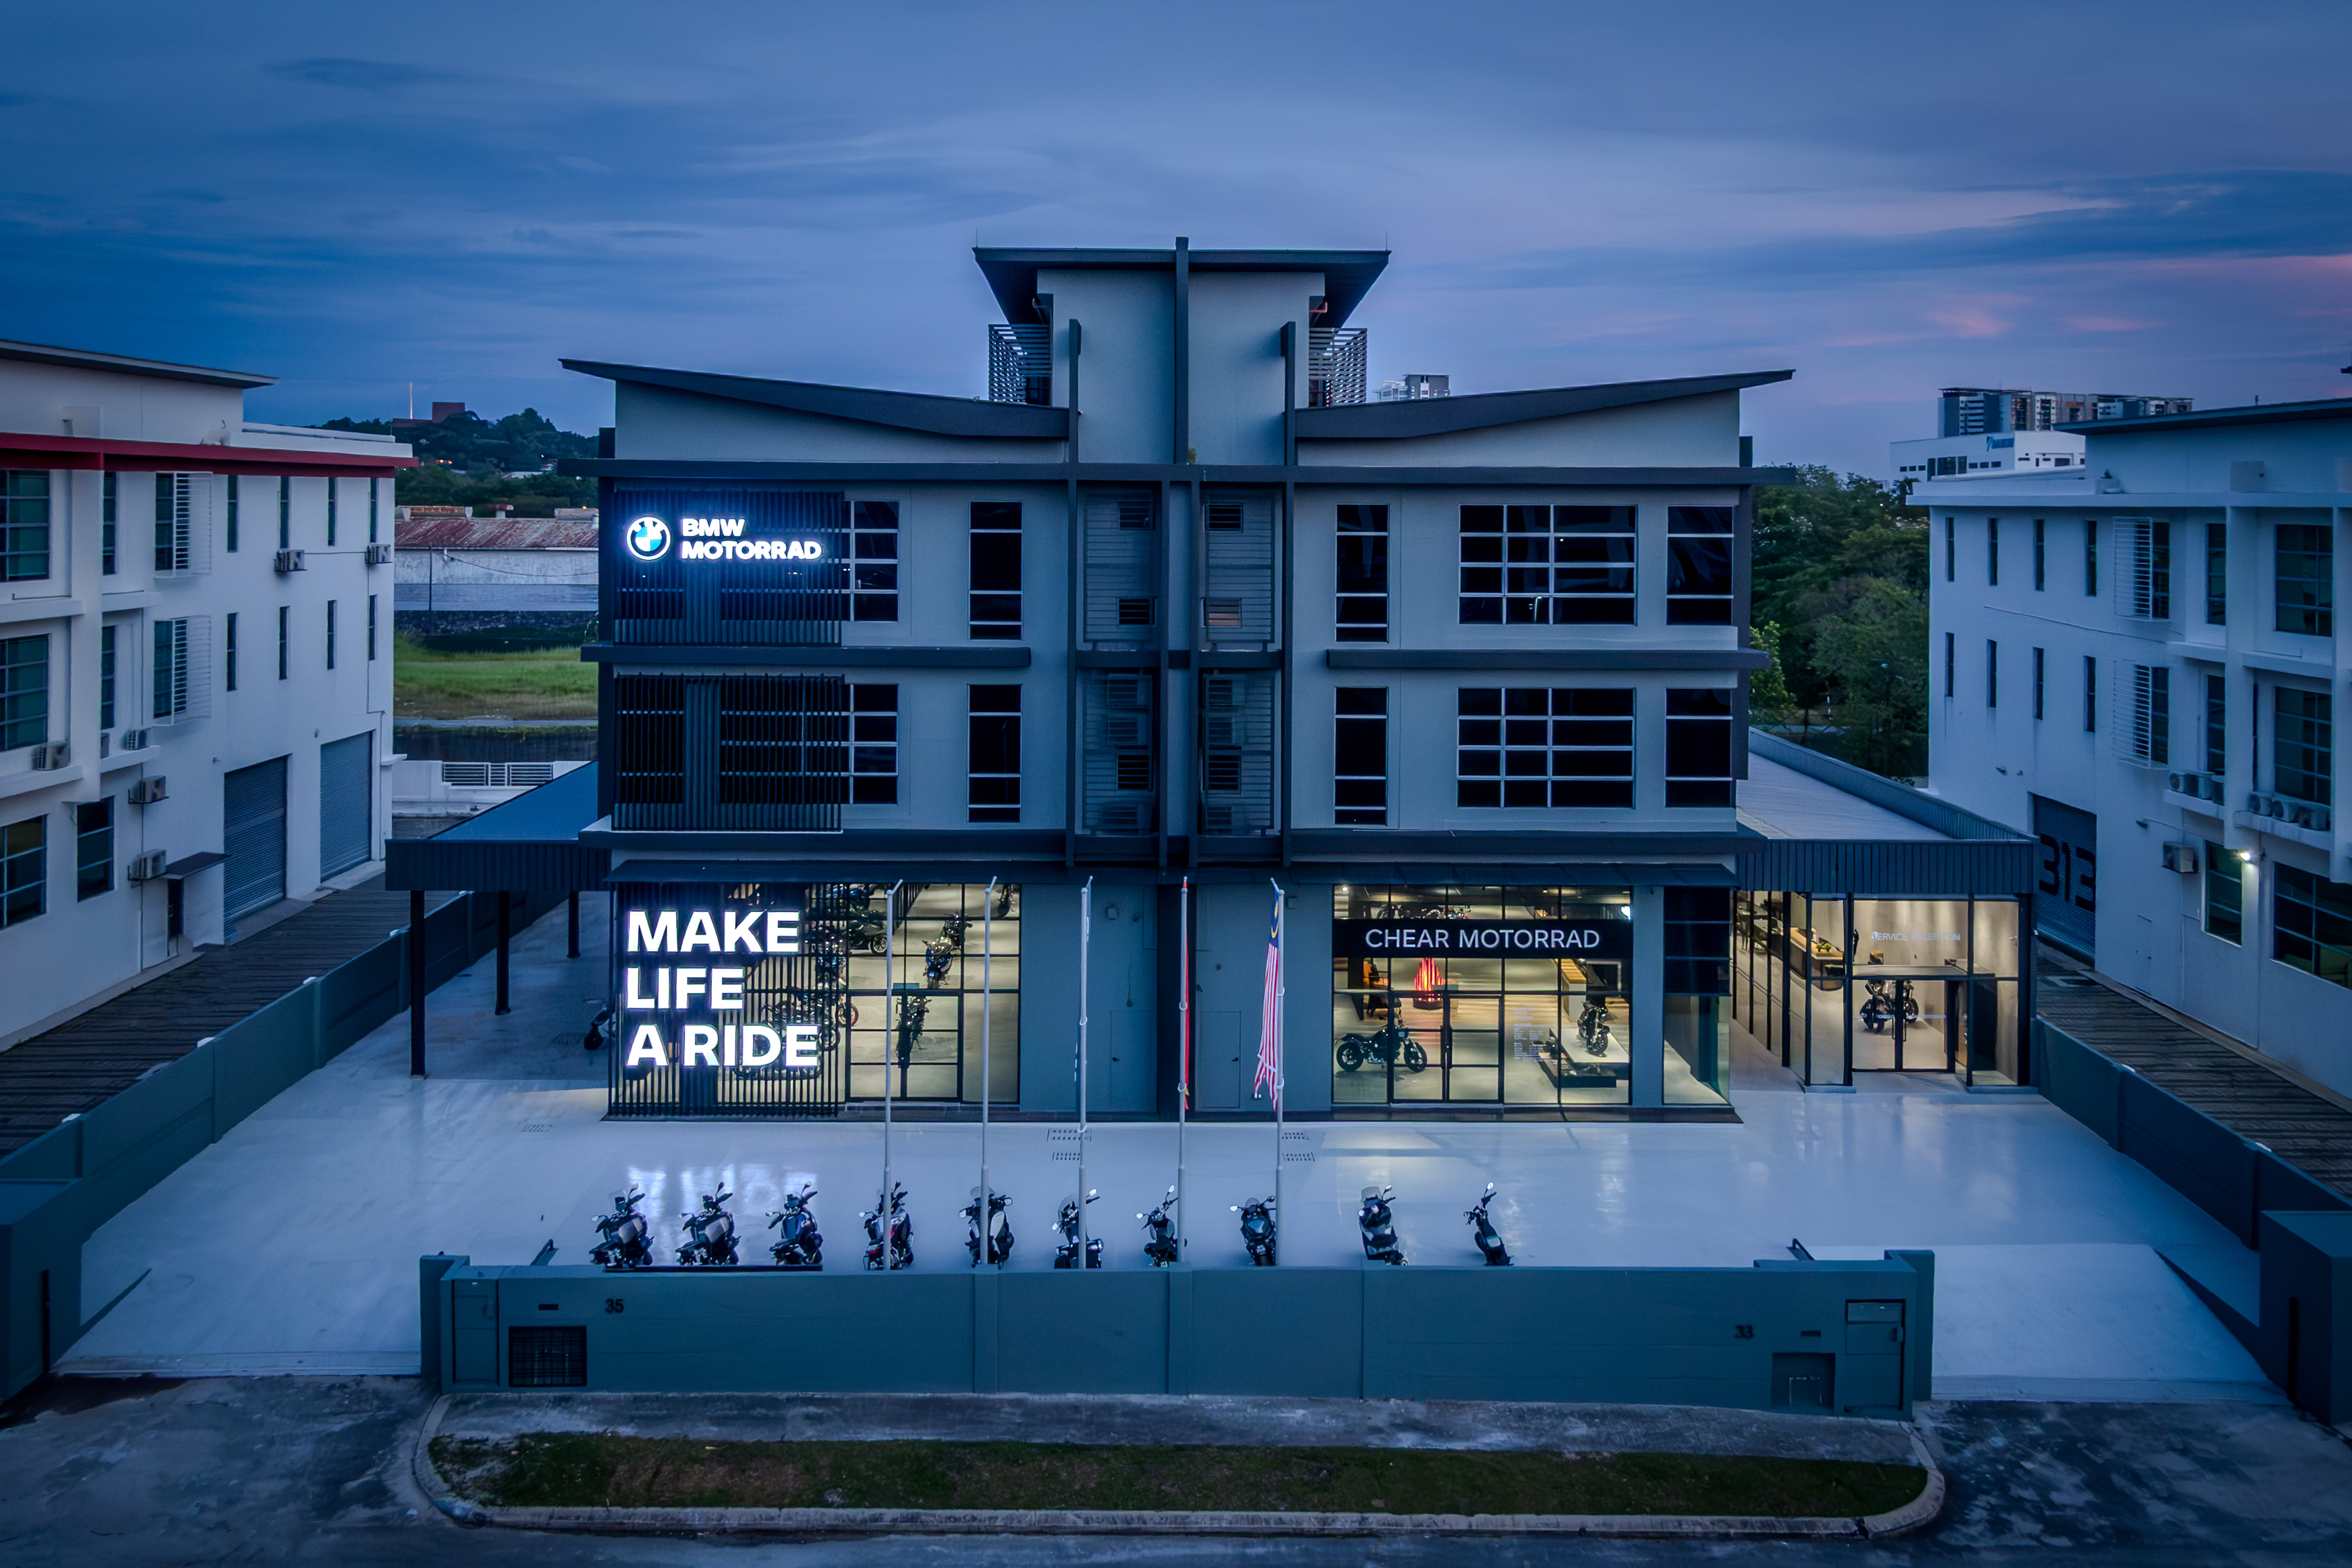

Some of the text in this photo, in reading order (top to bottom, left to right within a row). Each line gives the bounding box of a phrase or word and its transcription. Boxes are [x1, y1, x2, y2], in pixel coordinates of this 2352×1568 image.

[682, 518, 745, 537] BMW
[682, 541, 822, 559] MOTORRAD
[2039, 833, 2096, 914] 313
[628, 911, 799, 952] MAKE
[1365, 929, 1600, 948] CHEAR MOTORRAD
[1911, 933, 1960, 941] CEPON
[627, 967, 744, 1009] LIFE
[627, 1025, 818, 1066] A RIDE
[605, 1298, 624, 1314] 35
[1734, 1324, 1754, 1339] 33
